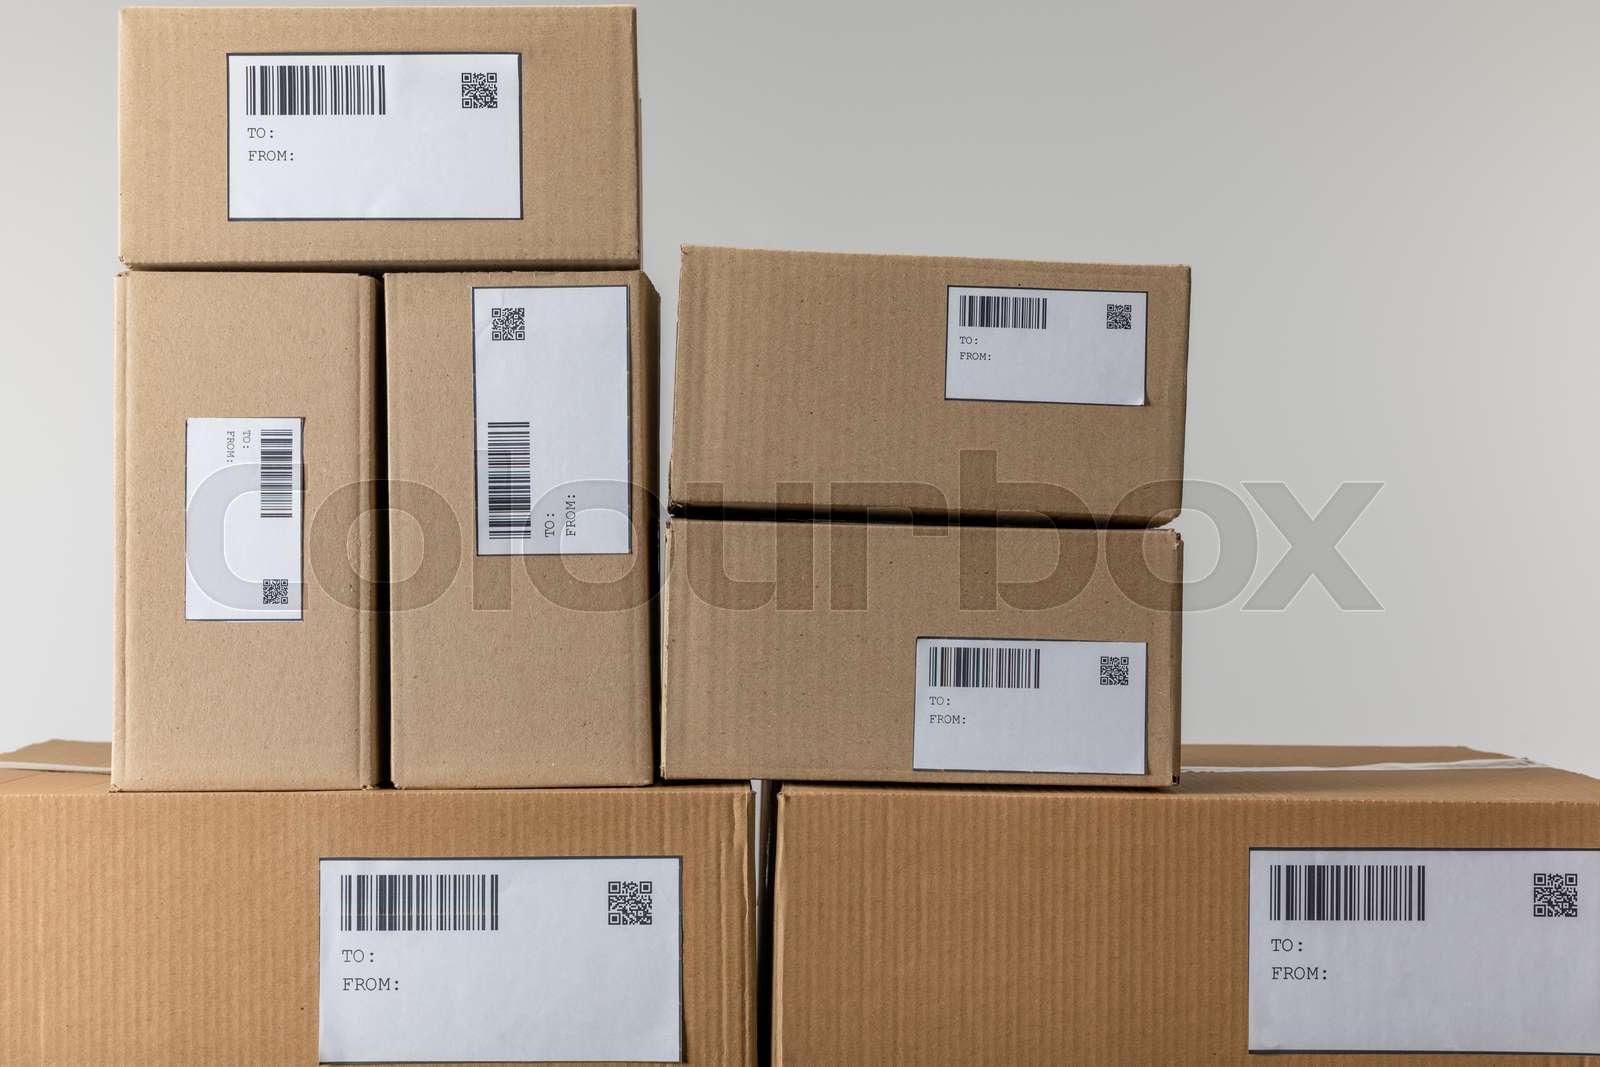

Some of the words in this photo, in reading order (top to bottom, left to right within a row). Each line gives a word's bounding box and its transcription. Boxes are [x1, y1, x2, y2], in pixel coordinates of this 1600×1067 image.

[246, 127, 274, 139] TO:
[247, 149, 294, 162] FROM:
[959, 335, 978, 345] TO:
[959, 351, 991, 361] FROM:
[226, 430, 236, 463] FROM:
[242, 429, 252, 449] TO:
[565, 494, 576, 537] FROM:
[544, 513, 556, 538] TO:
[928, 695, 951, 706] TO:
[929, 714, 966, 725] FROM:
[1270, 938, 1303, 953] TO:
[341, 948, 375, 963] TO:
[1271, 966, 1327, 981] FROM:
[342, 977, 399, 992] FROM:
